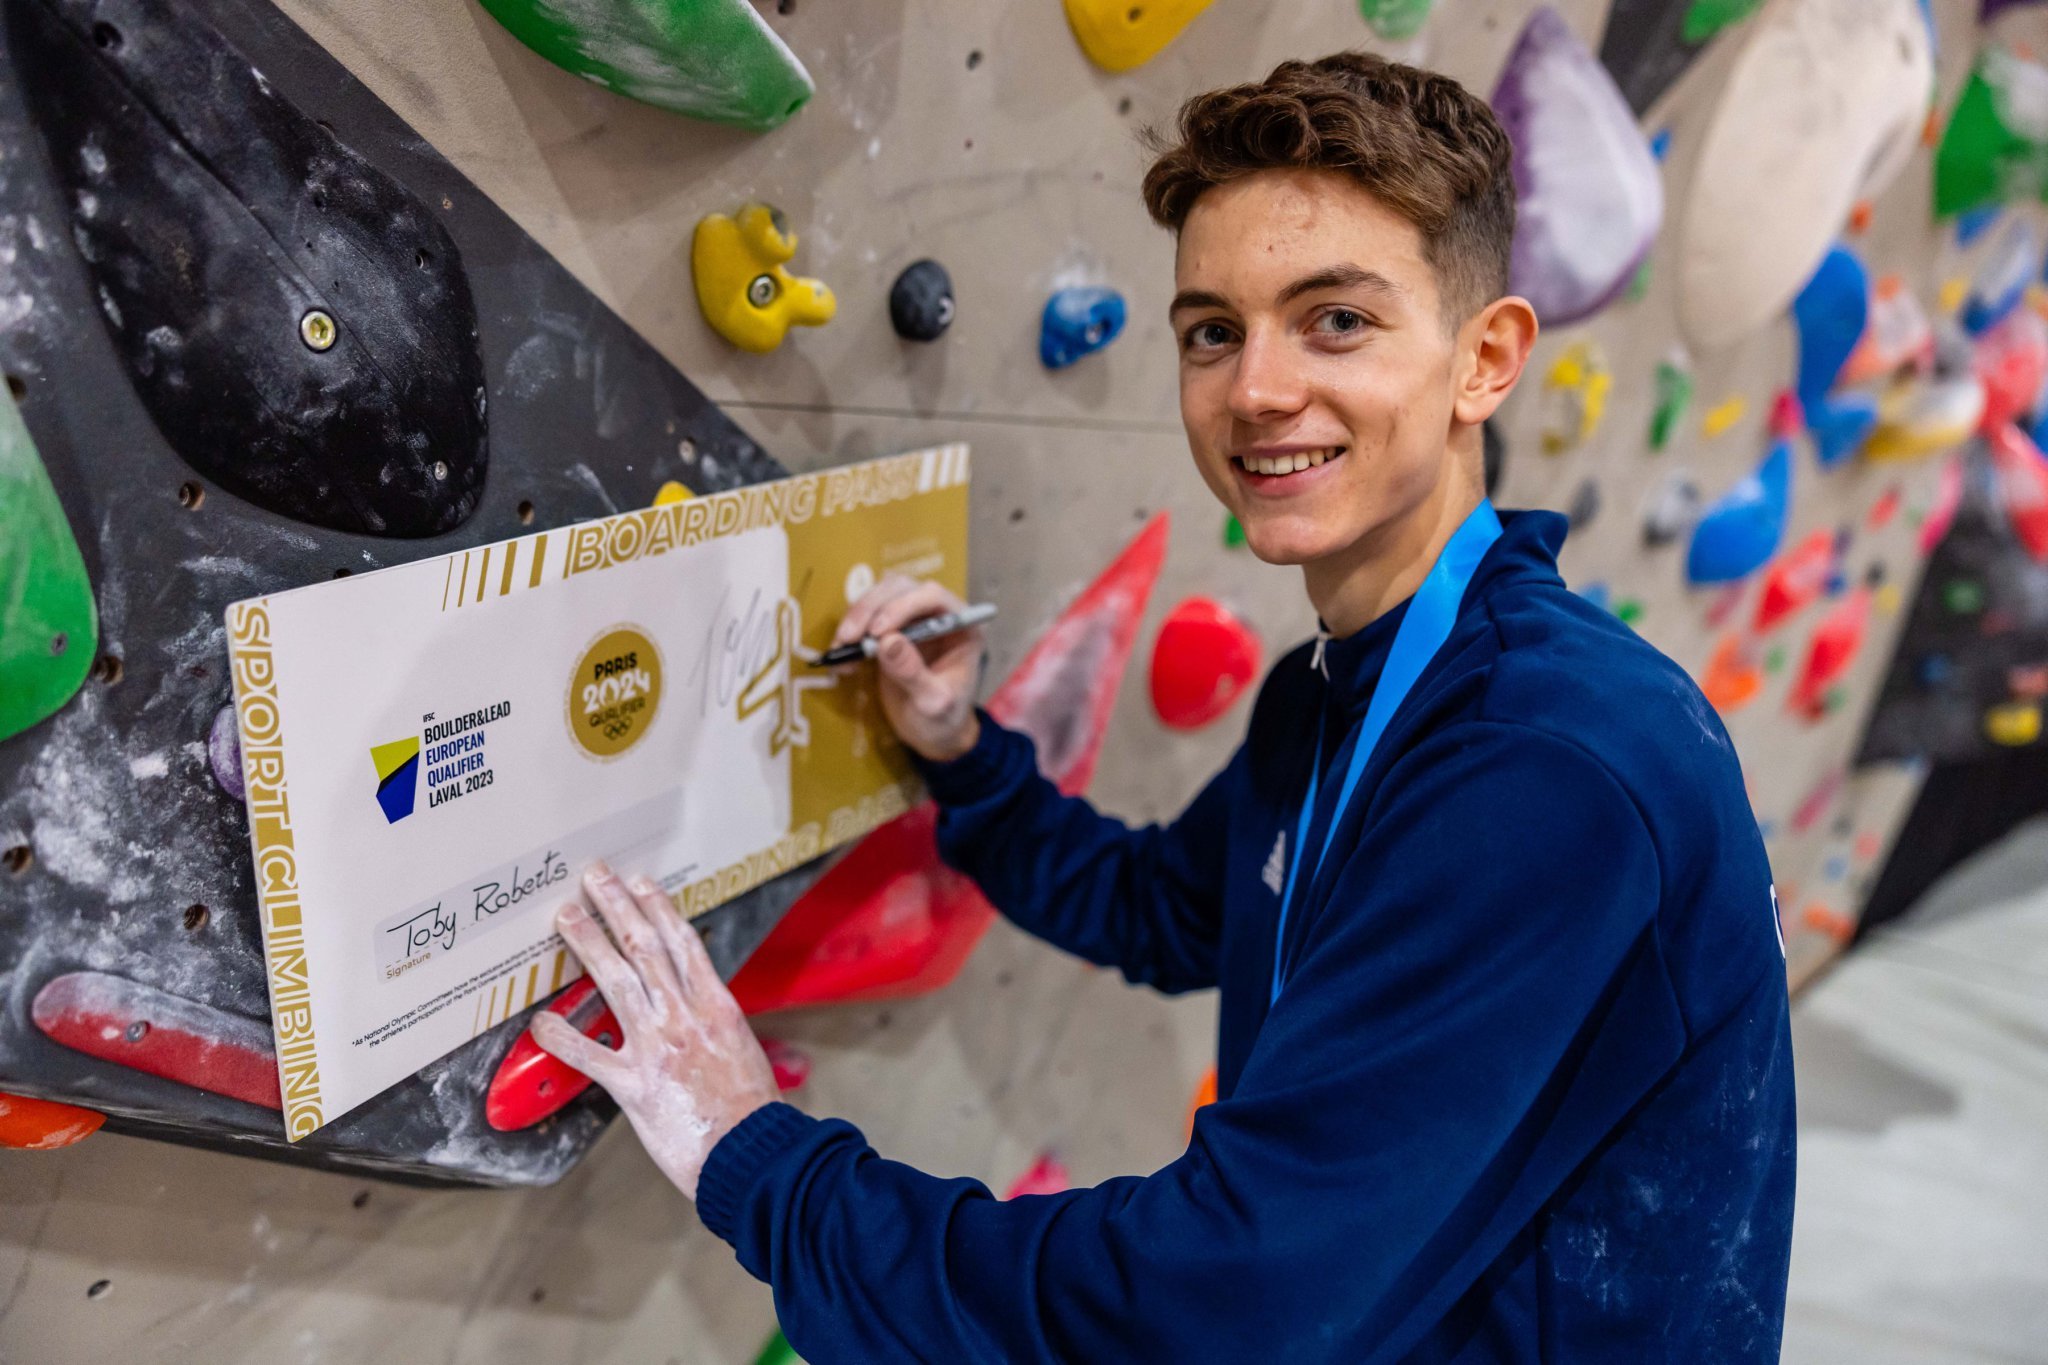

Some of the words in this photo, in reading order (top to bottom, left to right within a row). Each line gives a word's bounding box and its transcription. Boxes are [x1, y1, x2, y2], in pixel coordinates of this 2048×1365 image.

[570, 475, 820, 575] BOARDING
[594, 652, 637, 681] PARIS
[582, 667, 651, 714] 2024
[232, 601, 293, 830] SPORT
[422, 711, 435, 723] IFSC
[424, 701, 511, 745] BOULDER&LEAD
[426, 730, 485, 766] EUROPEAN
[427, 752, 484, 787] QUALIFIER
[429, 782, 463, 808] LAVAL
[465, 769, 494, 793] 2023
[386, 901, 456, 957] Toby
[473, 851, 568, 921] Roberts
[386, 951, 431, 980] Signature
[258, 843, 324, 1141] CLIMBING
[364, 1021, 391, 1042] National
[391, 1009, 416, 1027] Olympic
[369, 1038, 380, 1048] the
